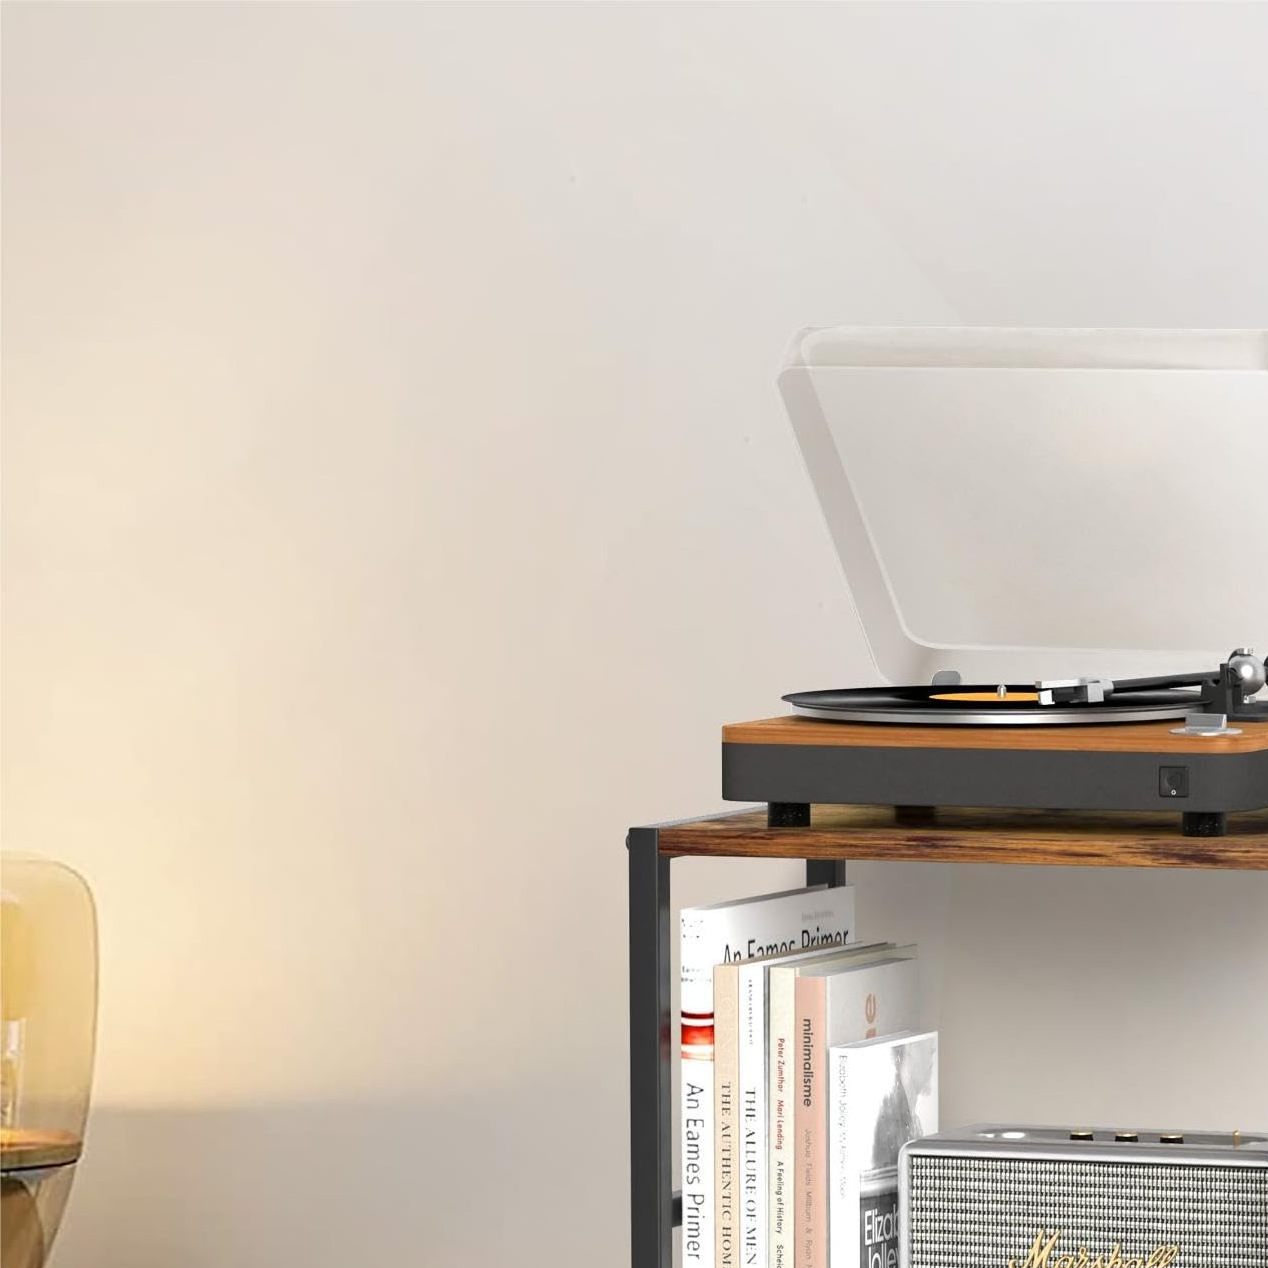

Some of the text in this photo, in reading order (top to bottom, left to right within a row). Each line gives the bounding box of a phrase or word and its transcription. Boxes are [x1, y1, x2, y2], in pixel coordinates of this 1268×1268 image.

[777, 1038, 786, 1058] Peter
[803, 1018, 814, 1107] minimalisme
[776, 1060, 785, 1092] Zumthor
[721, 1081, 732, 1117] THE
[776, 1099, 785, 1118] Mari
[775, 1120, 785, 1150] Lending
[686, 1082, 706, 1260] An Eames Primer
[721, 1120, 733, 1221] AUTHENTIC
[745, 1087, 758, 1265] THE ALLURE OF MEN
[775, 1168, 785, 1196] Feeling
[777, 1197, 785, 1206] of
[775, 1207, 785, 1234] History
[864, 1203, 900, 1246] Elizab
